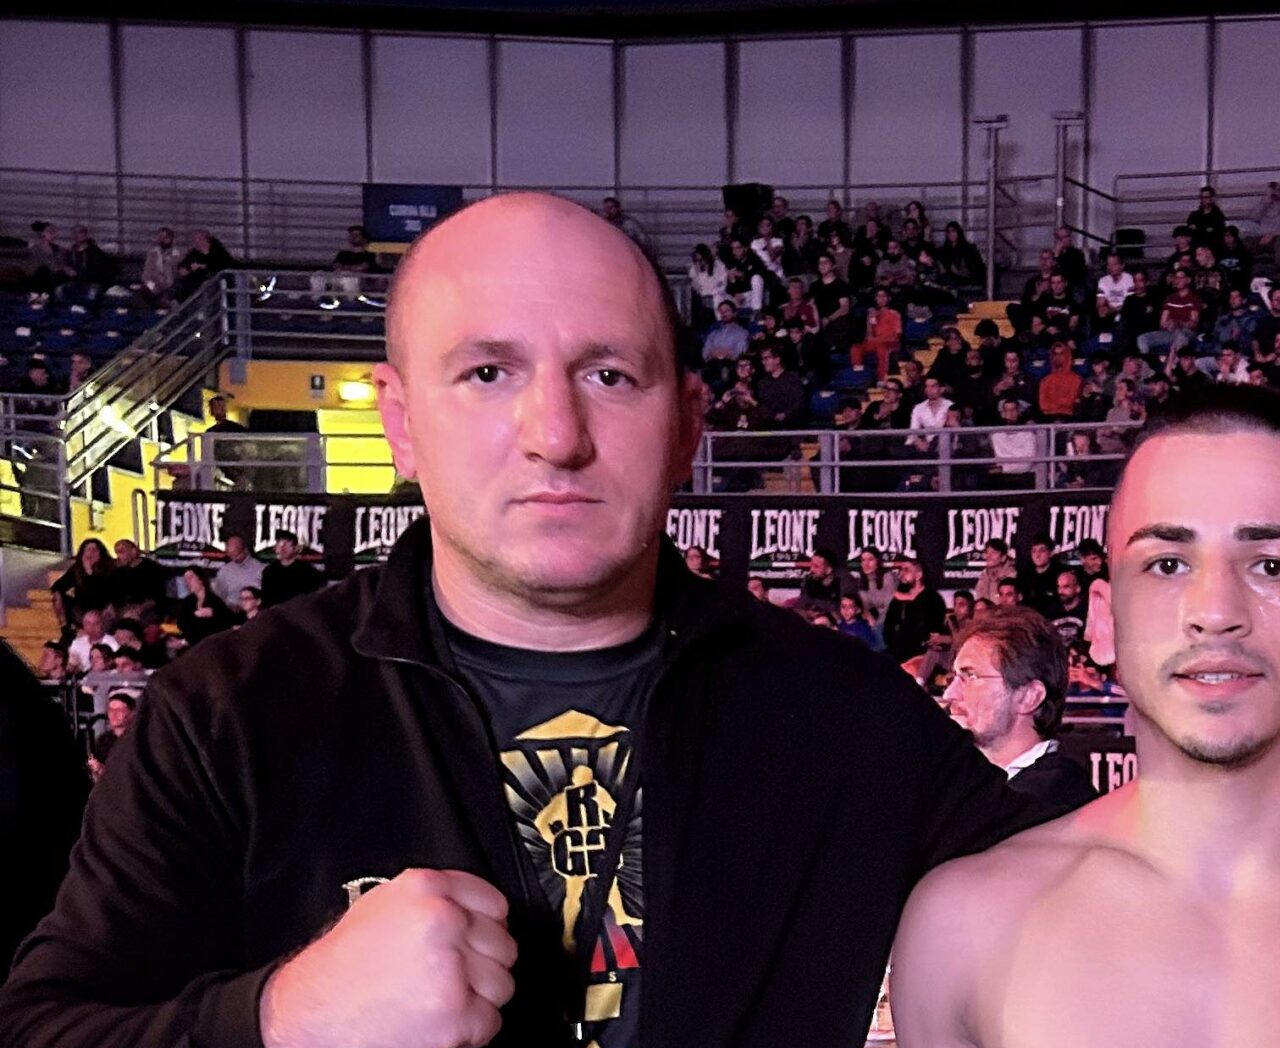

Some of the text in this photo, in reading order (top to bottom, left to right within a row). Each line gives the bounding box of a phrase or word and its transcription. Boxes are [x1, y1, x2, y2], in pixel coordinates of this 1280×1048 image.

[157, 500, 226, 551] LEONE
[254, 504, 327, 552] LEONE
[354, 505, 425, 554] LEON
[666, 509, 721, 559] EONE
[750, 509, 820, 560] LEONE
[847, 510, 918, 560] LEONE
[946, 507, 1019, 559] LEONE
[1050, 504, 1109, 554] LEON
